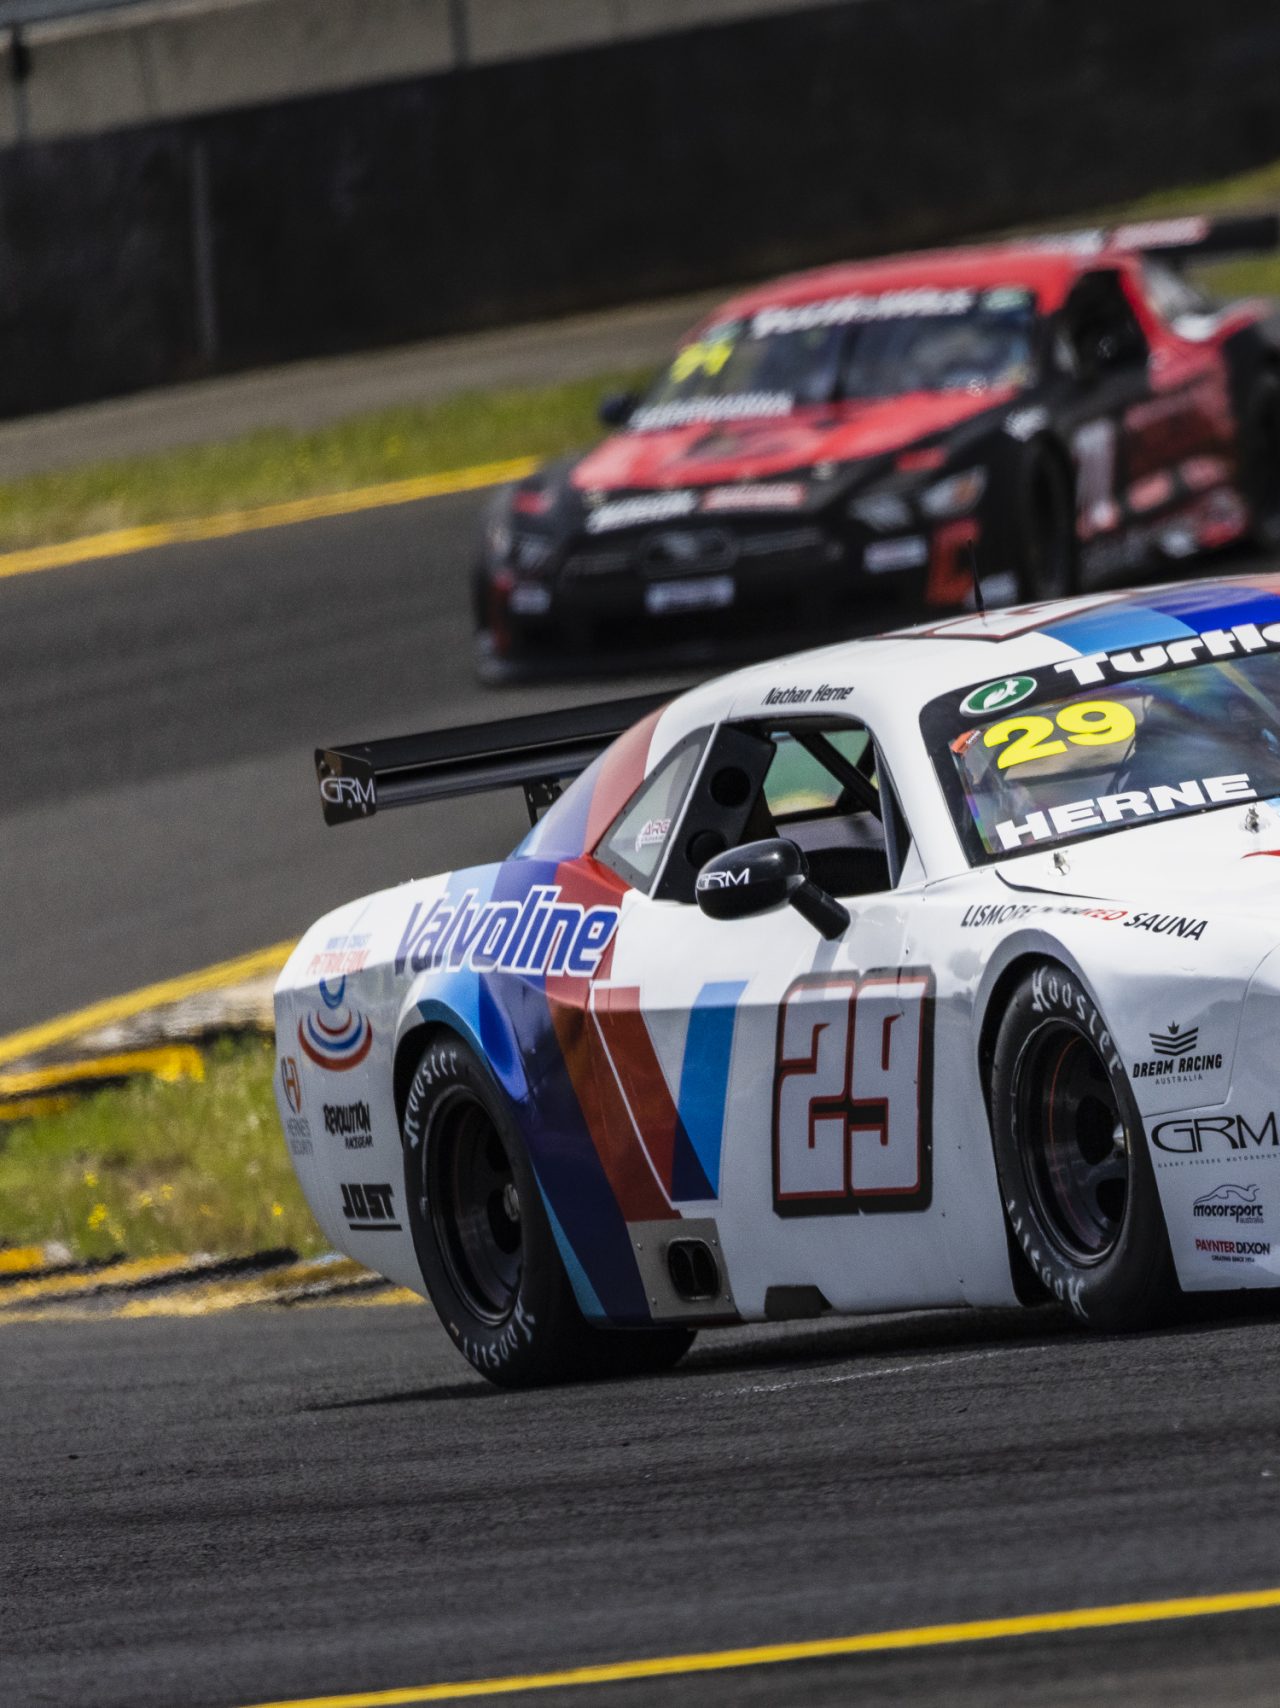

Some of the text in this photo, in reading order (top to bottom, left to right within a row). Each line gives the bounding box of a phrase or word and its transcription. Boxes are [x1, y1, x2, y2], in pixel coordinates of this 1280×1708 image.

[761, 684, 855, 705] Nathan Herne
[984, 700, 1136, 769] 29
[320, 777, 376, 804] GRM
[995, 773, 1257, 850] HERNE
[395, 884, 621, 977] Valvoline
[1123, 912, 1208, 941] SAUNA
[1032, 966, 1122, 1072] Hoosier
[1132, 1054, 1223, 1078] DREAM RACING
[1155, 1074, 1203, 1085] AUSTRALIA
[772, 965, 937, 1220] 29
[323, 1100, 371, 1136] REVOLUTION
[1151, 1111, 1280, 1154] GRM
[1193, 1204, 1263, 1223] motorsport
